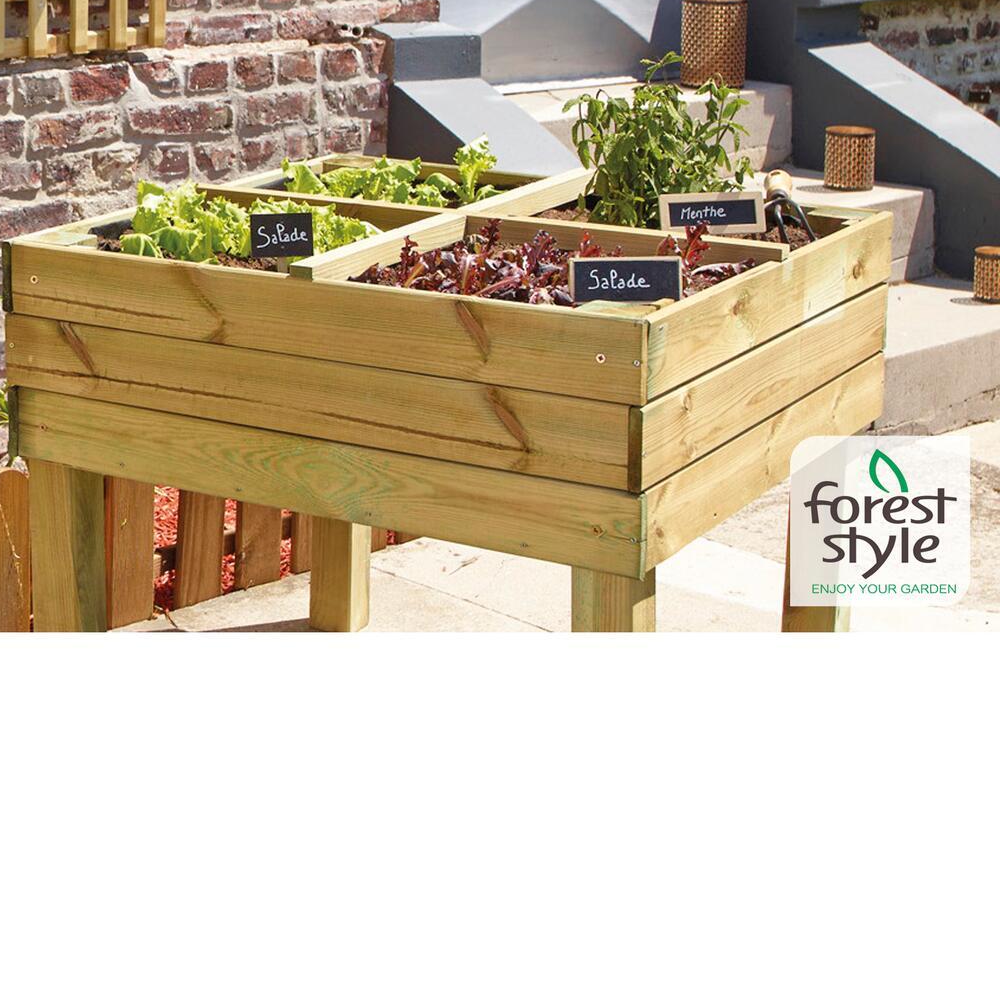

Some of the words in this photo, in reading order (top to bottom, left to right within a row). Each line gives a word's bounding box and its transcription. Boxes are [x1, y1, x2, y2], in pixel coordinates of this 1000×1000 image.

[680, 205, 727, 220] Menthe
[256, 223, 309, 249] Salade
[588, 269, 651, 290] Salade
